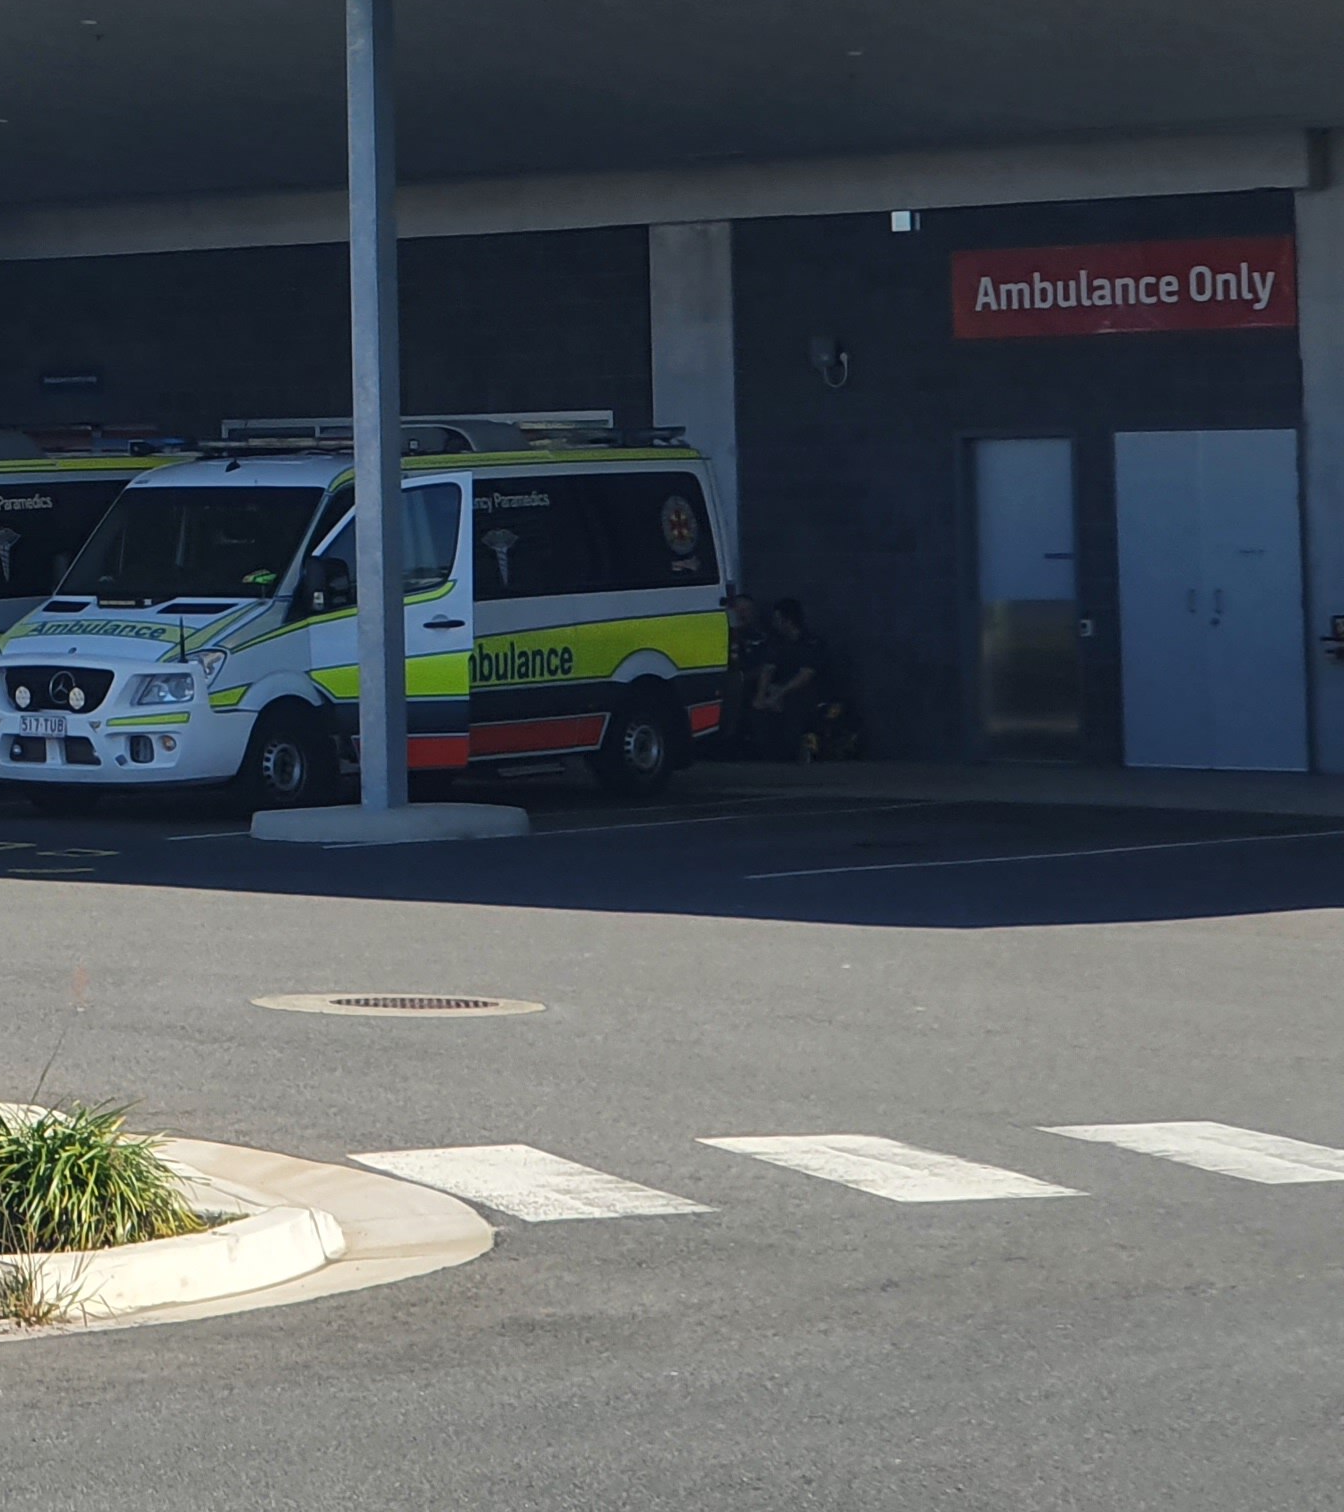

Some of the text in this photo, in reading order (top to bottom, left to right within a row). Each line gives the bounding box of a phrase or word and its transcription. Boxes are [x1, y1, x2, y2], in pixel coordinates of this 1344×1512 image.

[974, 262, 1276, 312] Ambulance Only
[493, 491, 551, 510] Paramedics
[28, 619, 167, 639] Ambulance
